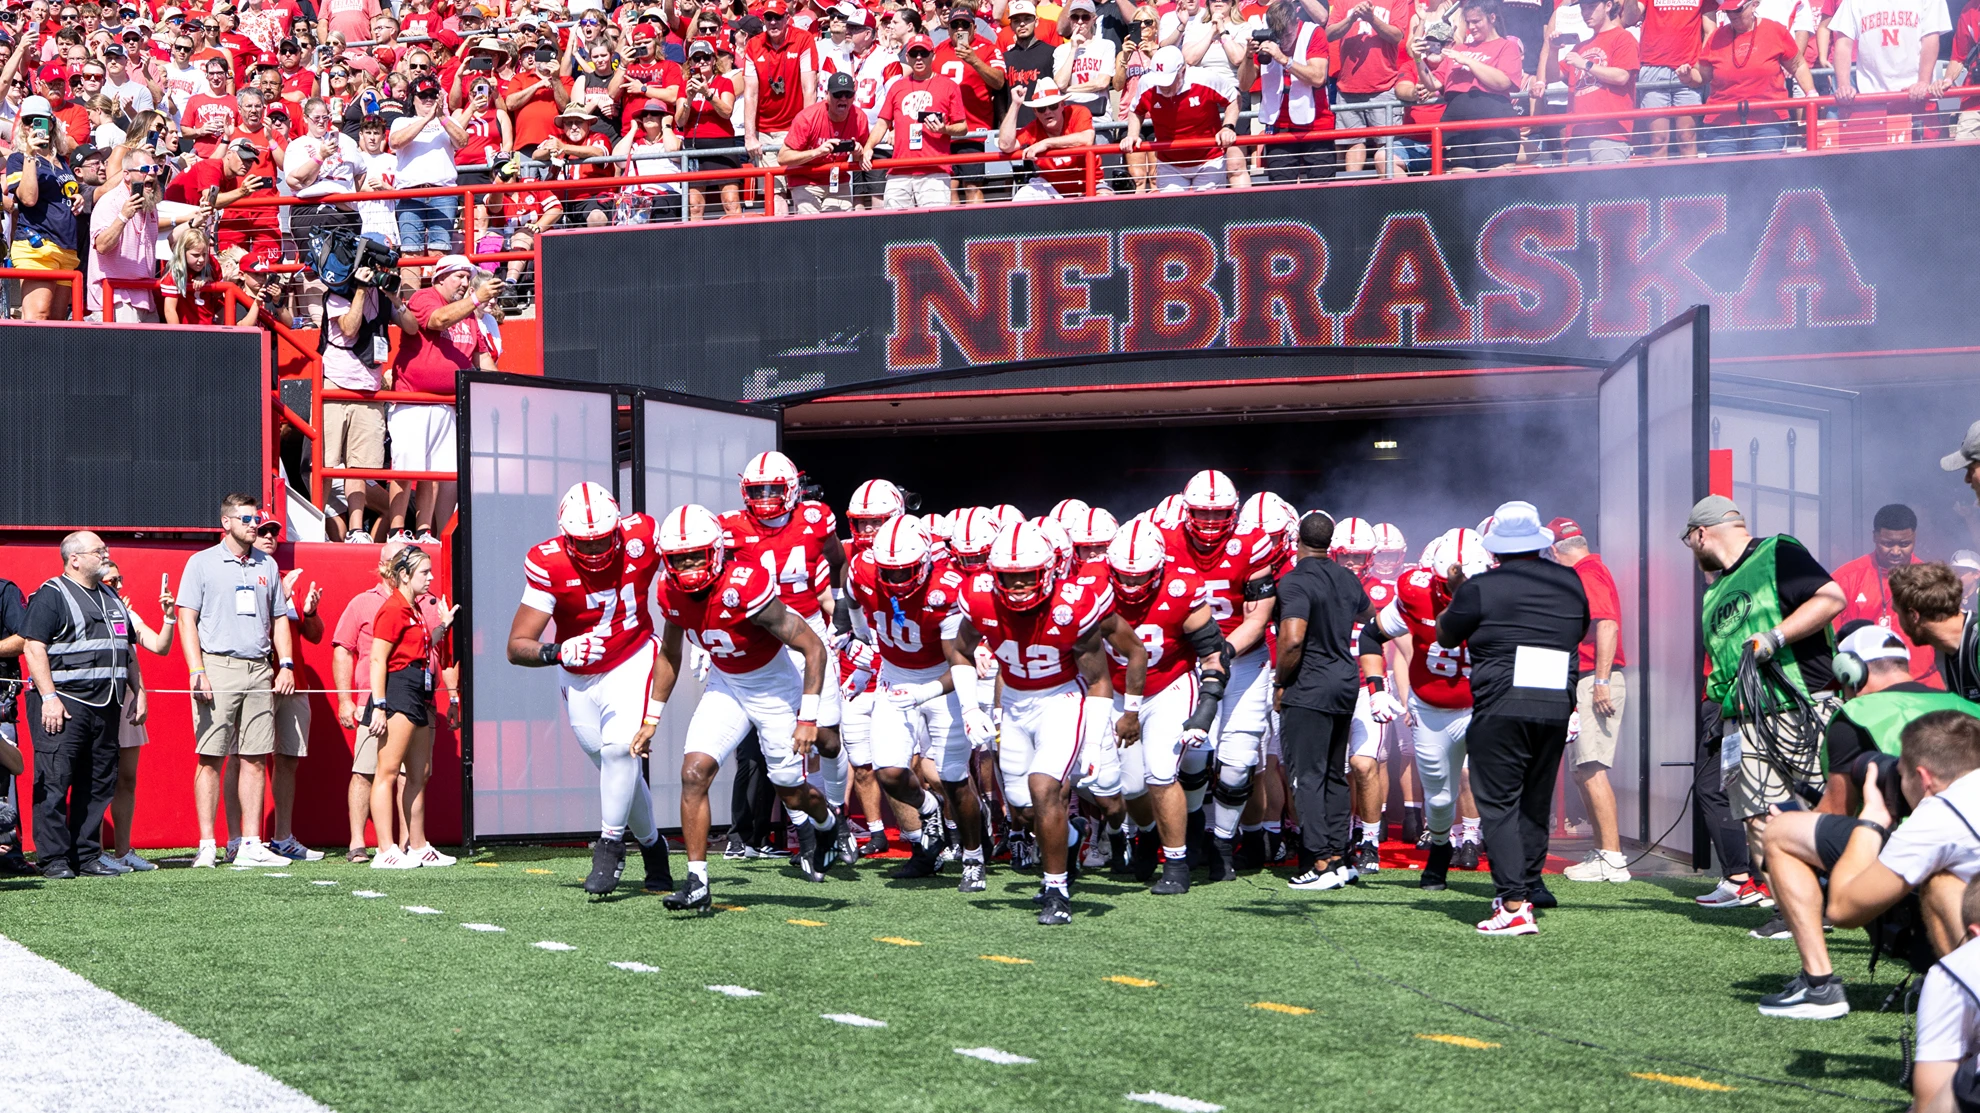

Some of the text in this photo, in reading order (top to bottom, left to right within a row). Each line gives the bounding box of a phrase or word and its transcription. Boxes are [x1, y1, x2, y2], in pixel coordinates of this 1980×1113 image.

[1861, 11, 1919, 33] NEBRASKA
[1881, 29, 1899, 46] N
[72, 63, 81, 72] N
[1006, 66, 1041, 86] Huskers
[1156, 64, 1163, 72] N
[1077, 73, 1089, 84] N
[1189, 96, 1201, 107] N
[382, 173, 395, 187] N
[884, 187, 1877, 371] NEBRASKA
[261, 511, 270, 520] N
[730, 567, 754, 586] 12
[760, 546, 809, 595] 14
[258, 575, 268, 586] N
[940, 571, 963, 589] 10
[1060, 583, 1084, 604] 42
[586, 582, 638, 636] 71
[1718, 596, 1740, 625] FOX
[873, 611, 923, 652] 10
[1717, 615, 1741, 631] SPORTS
[994, 639, 1062, 679] 42
